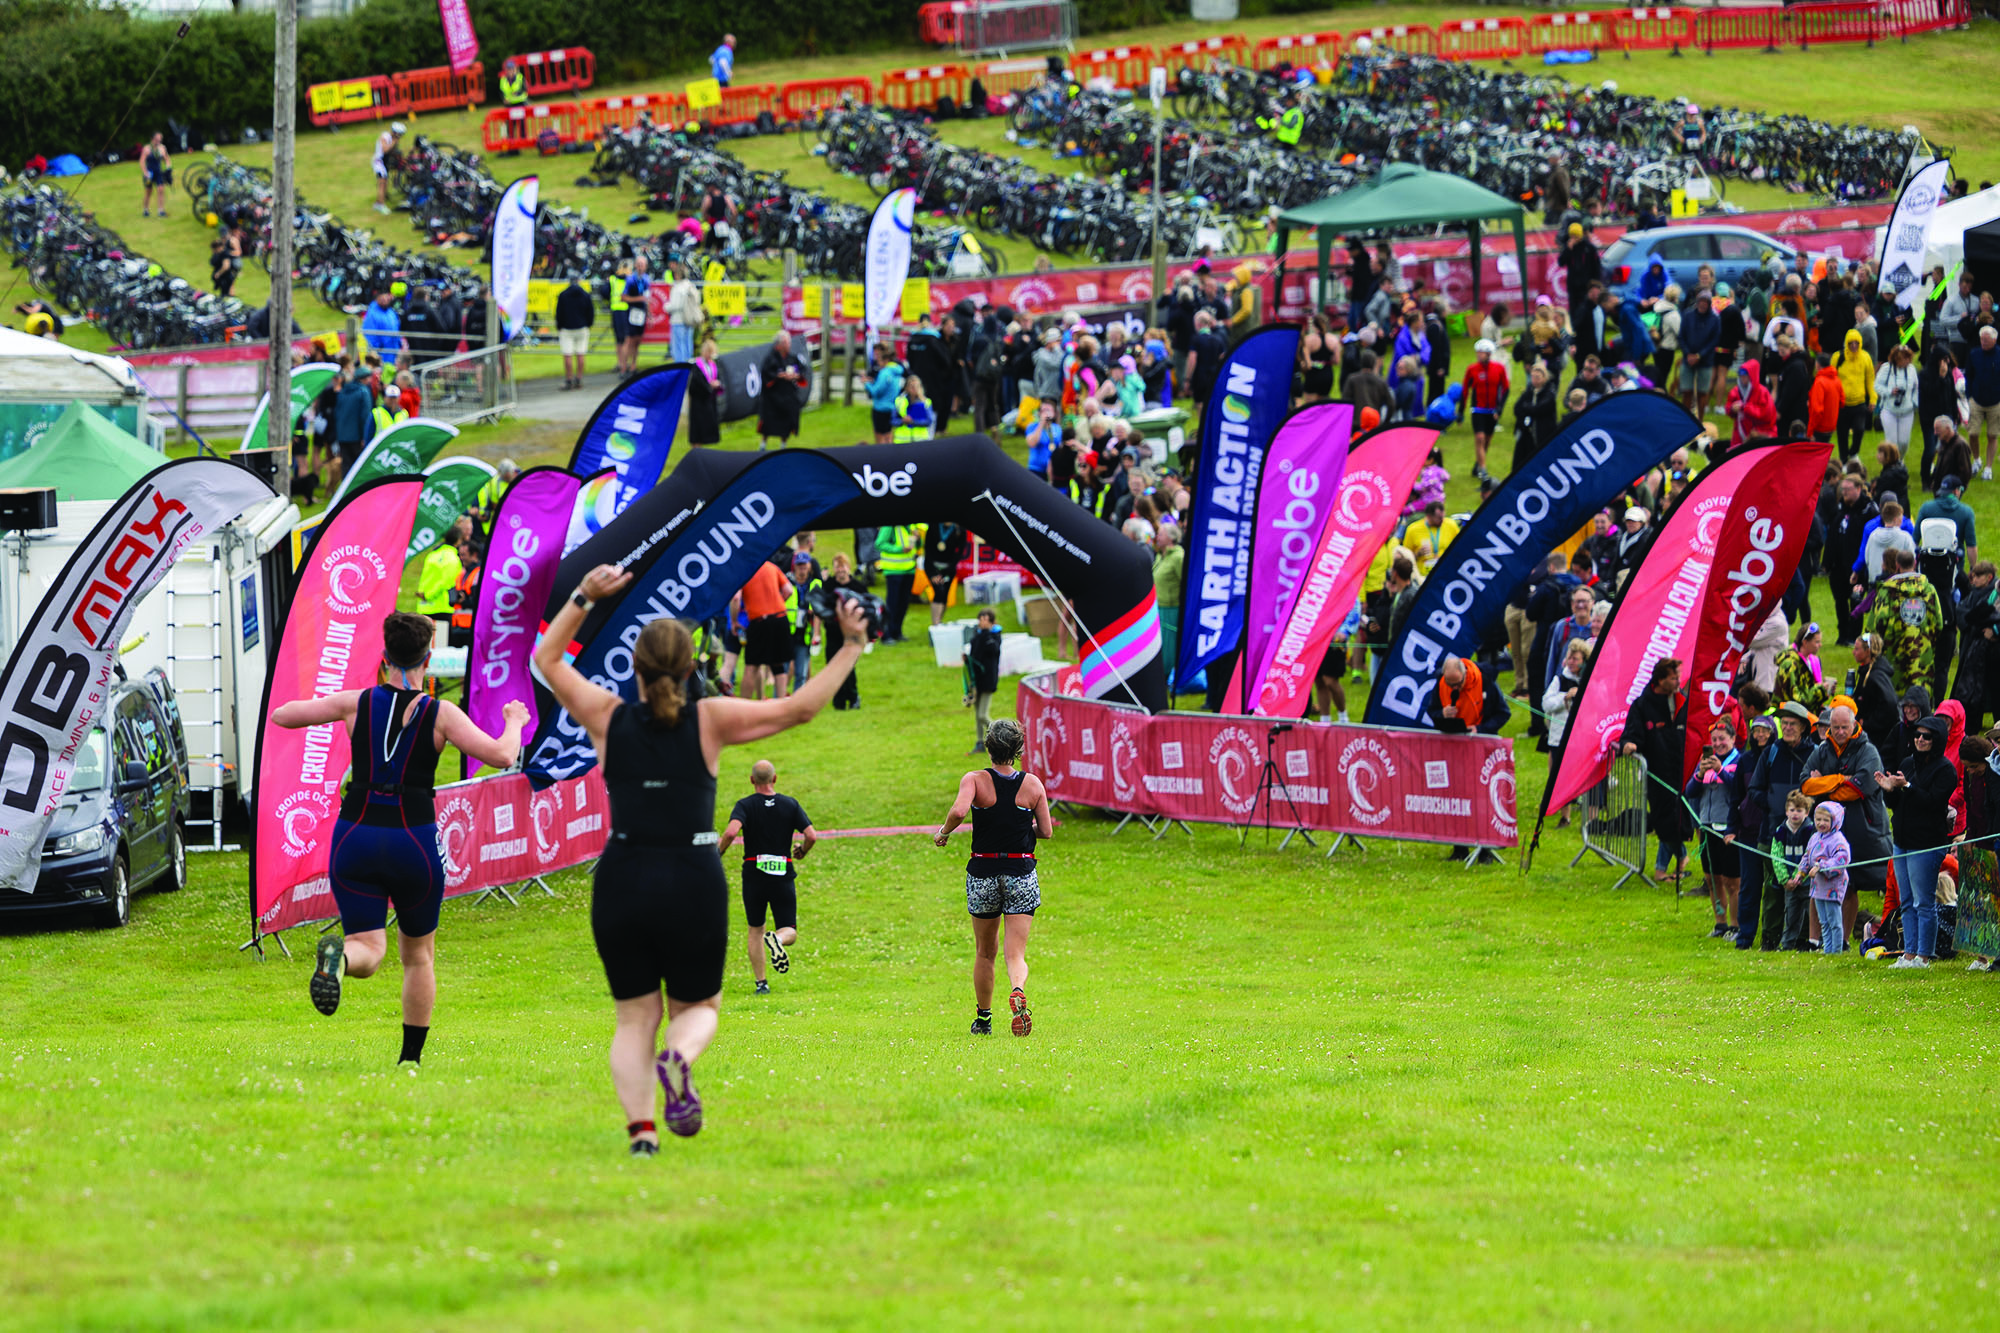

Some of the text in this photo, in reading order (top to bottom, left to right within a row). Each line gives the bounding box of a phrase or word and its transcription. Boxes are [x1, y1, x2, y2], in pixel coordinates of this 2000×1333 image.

[1211, 362, 1257, 514] ACTION
[1232, 446, 1263, 596] NORTH DEVON
[72, 490, 188, 647] MAX
[321, 545, 388, 580] CROYDE OCEAN
[616, 540, 652, 569] hanged.
[324, 594, 373, 616] TRIATHLON
[1276, 530, 1356, 666] CROYDEOCEAN.CO.UK
[58, 708, 93, 764] TIMING
[1595, 710, 1627, 734] CROYD
[1208, 725, 1237, 765] CROYDE
[1236, 727, 1263, 767] OCEAN
[1337, 736, 1367, 775] CROYDE
[1367, 738, 1397, 779] OCEAN
[1479, 747, 1508, 786] CROYDE
[274, 789, 311, 819] CROYDE
[1348, 802, 1392, 827] TRIATHLON
[1490, 816, 1519, 838] TRIATH
[760, 861, 782, 871] 461
